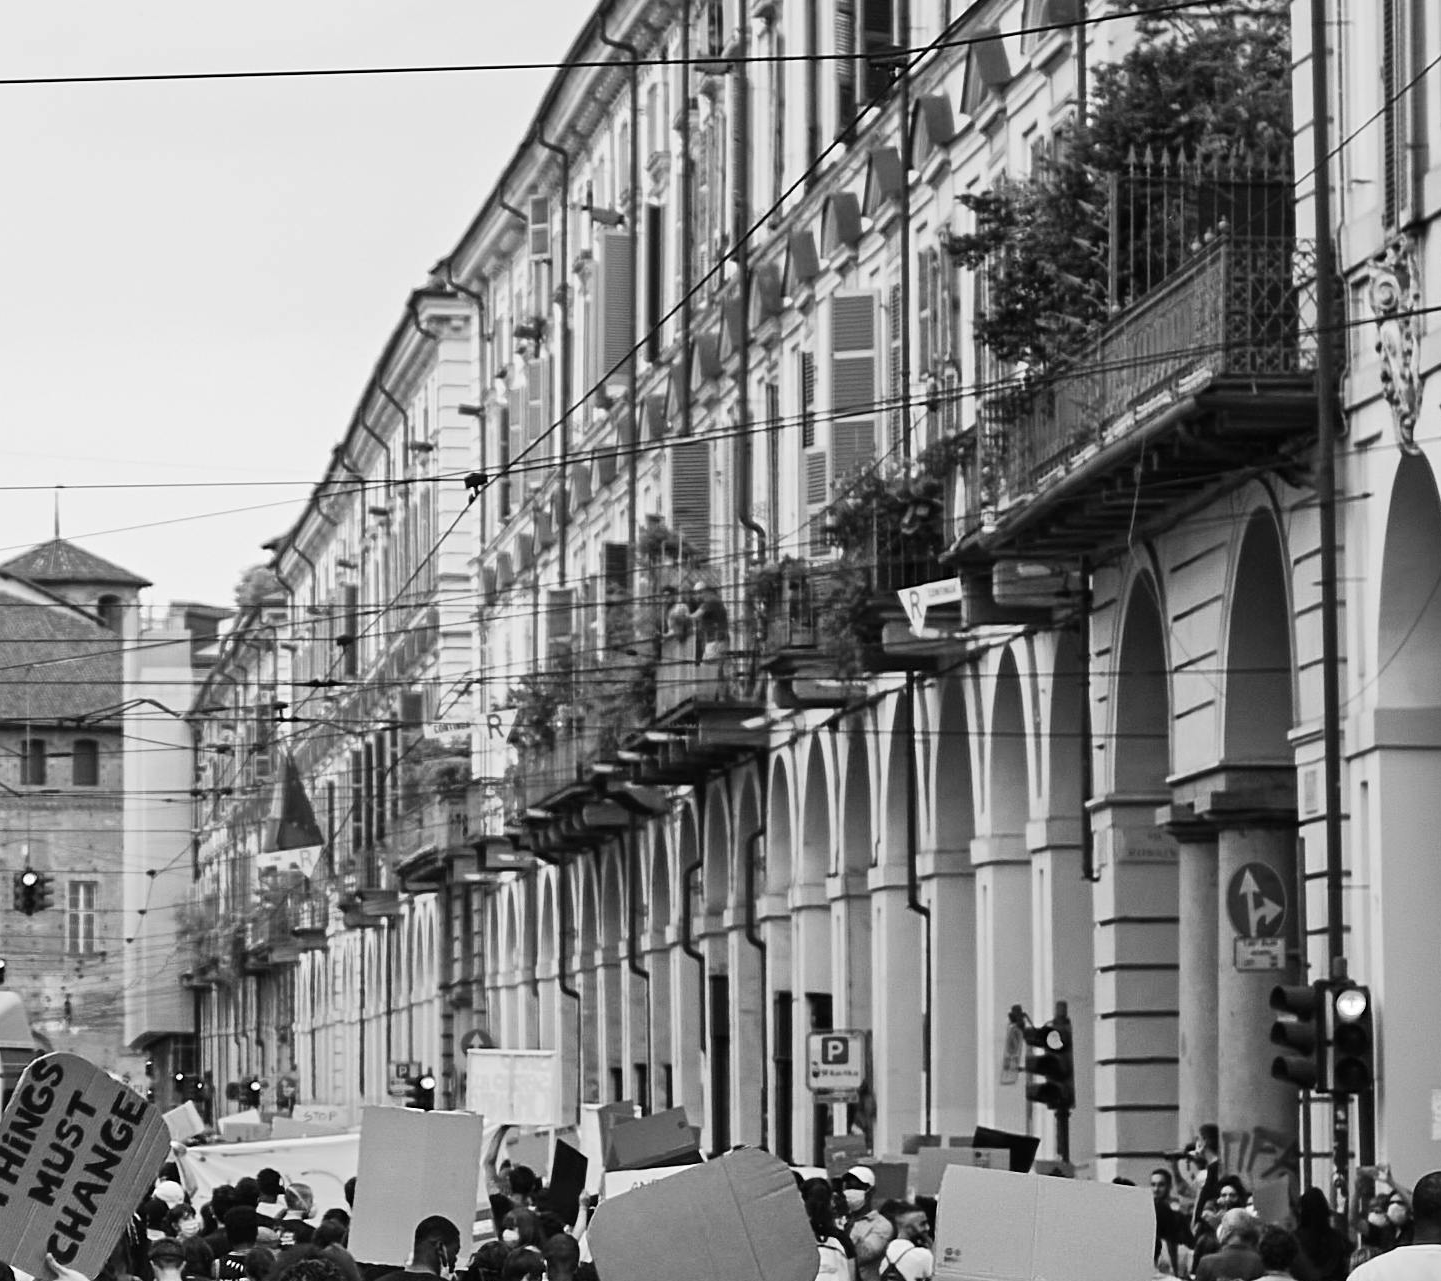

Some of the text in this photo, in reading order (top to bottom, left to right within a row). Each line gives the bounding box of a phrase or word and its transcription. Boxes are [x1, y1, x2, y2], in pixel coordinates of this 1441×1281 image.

[28, 1090, 97, 1207] MUST
[303, 1111, 338, 1122] STOP
[46, 1090, 148, 1265] CHANGE
